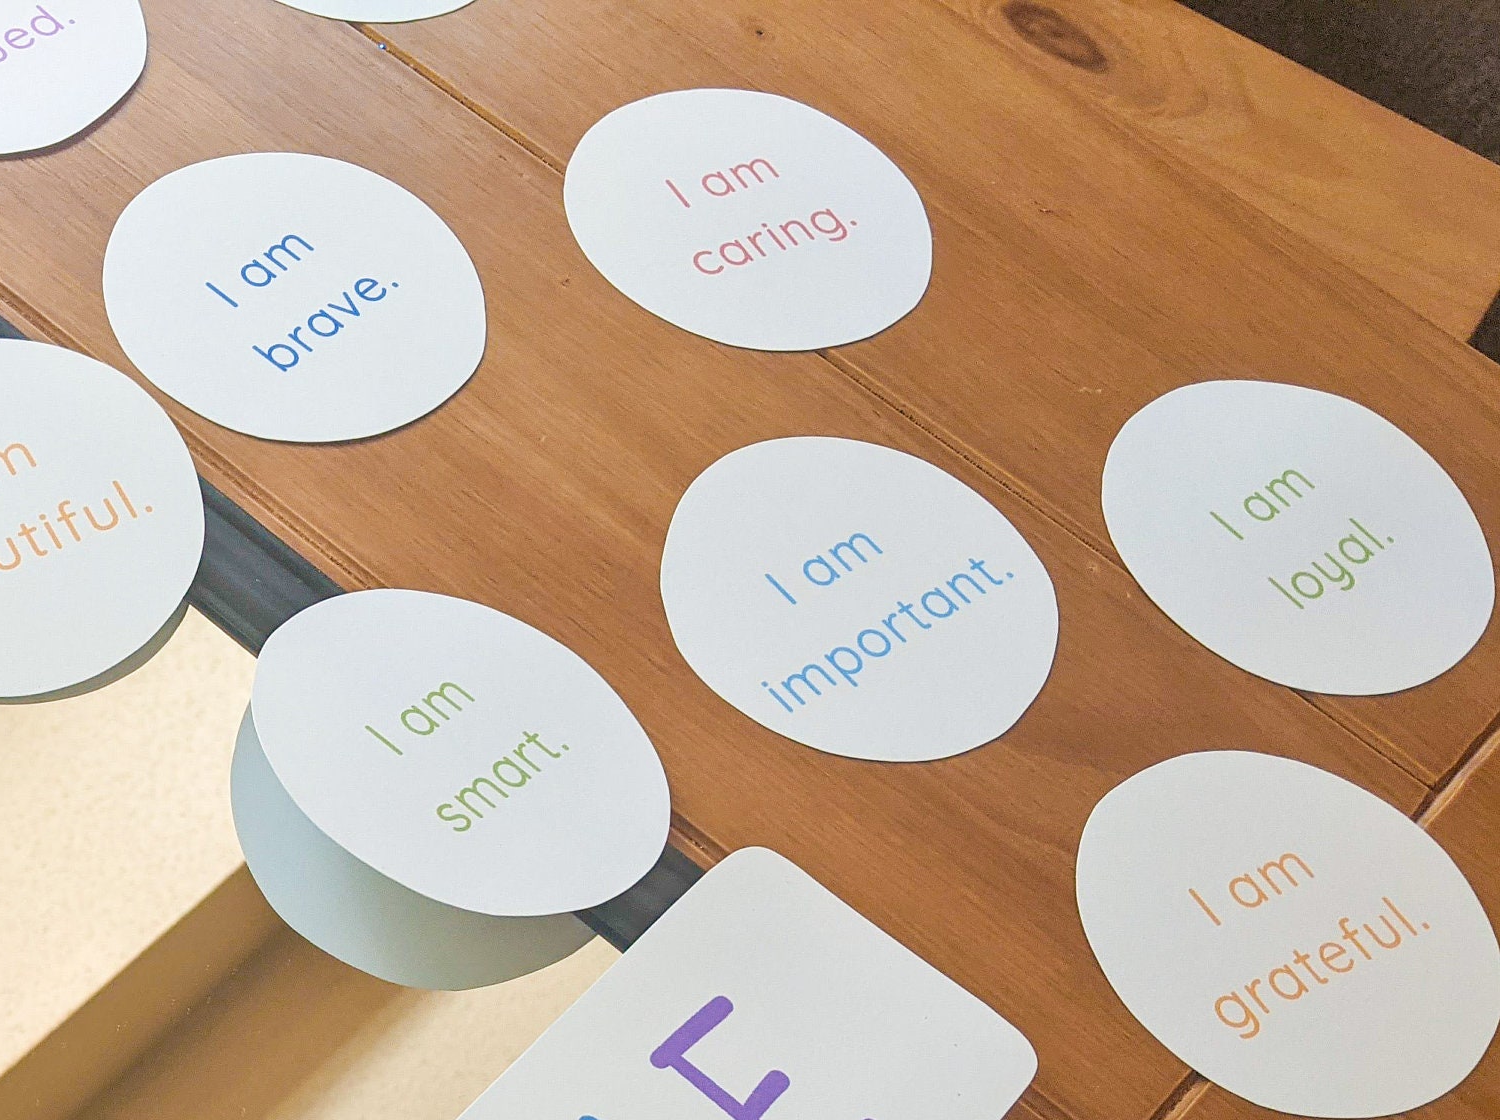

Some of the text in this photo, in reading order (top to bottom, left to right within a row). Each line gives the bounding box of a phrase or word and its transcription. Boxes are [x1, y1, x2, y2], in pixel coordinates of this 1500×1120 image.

[664, 150, 780, 210] I am
[204, 230, 316, 309] I am
[692, 206, 858, 276] caring.
[251, 278, 400, 373] brave.
[1209, 464, 1316, 542] I am
[763, 530, 884, 606] I am
[1266, 520, 1395, 611] loyal.
[760, 555, 1015, 715] important.
[363, 680, 477, 758] I am
[435, 730, 572, 836] smart.
[1187, 850, 1316, 928] I am
[1212, 895, 1432, 1040] grateful.
